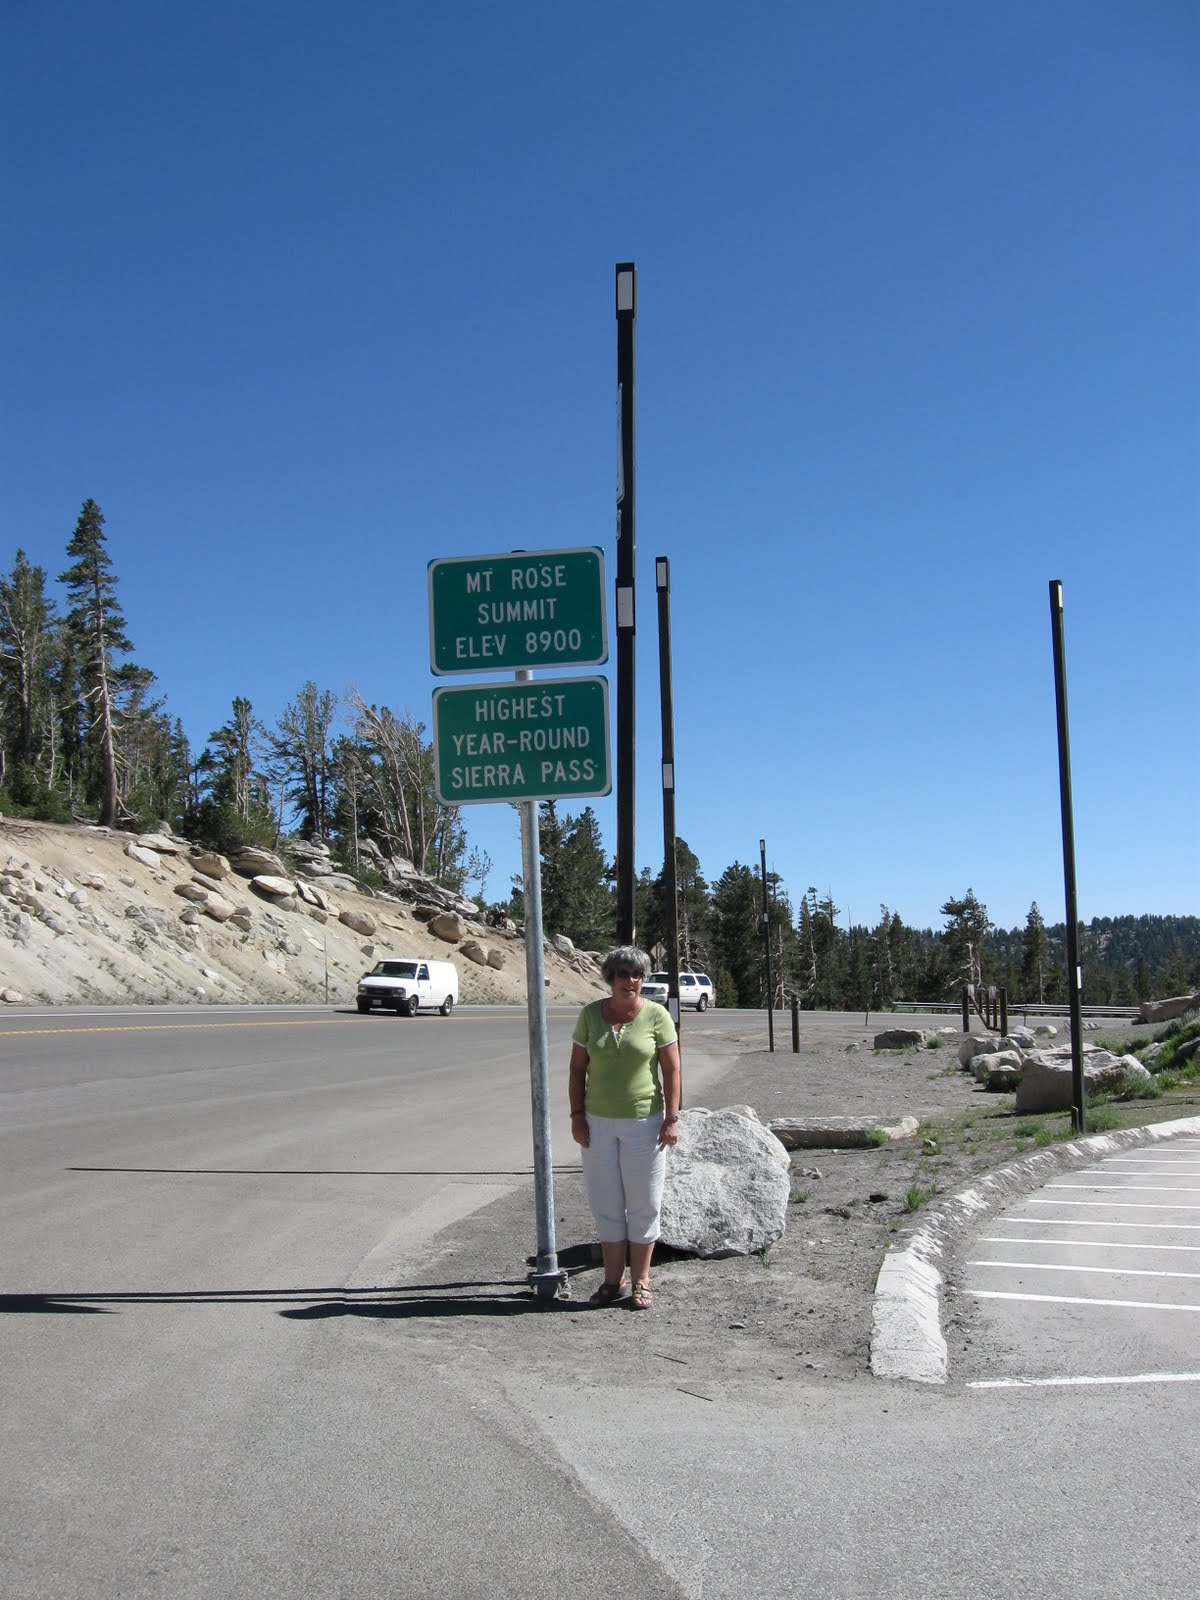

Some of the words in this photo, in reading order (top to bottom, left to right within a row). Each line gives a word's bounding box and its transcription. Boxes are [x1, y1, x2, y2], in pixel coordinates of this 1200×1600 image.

[466, 571, 493, 593] MT
[511, 565, 567, 590] ROSE
[478, 598, 557, 624] SUMMIT
[456, 634, 507, 659] ELEV
[525, 629, 581, 654] 8900
[475, 695, 565, 722] HIGHEST
[452, 726, 590, 756] YEAR-ROUND
[451, 763, 525, 789] SIERRA
[541, 758, 595, 783] PASS
